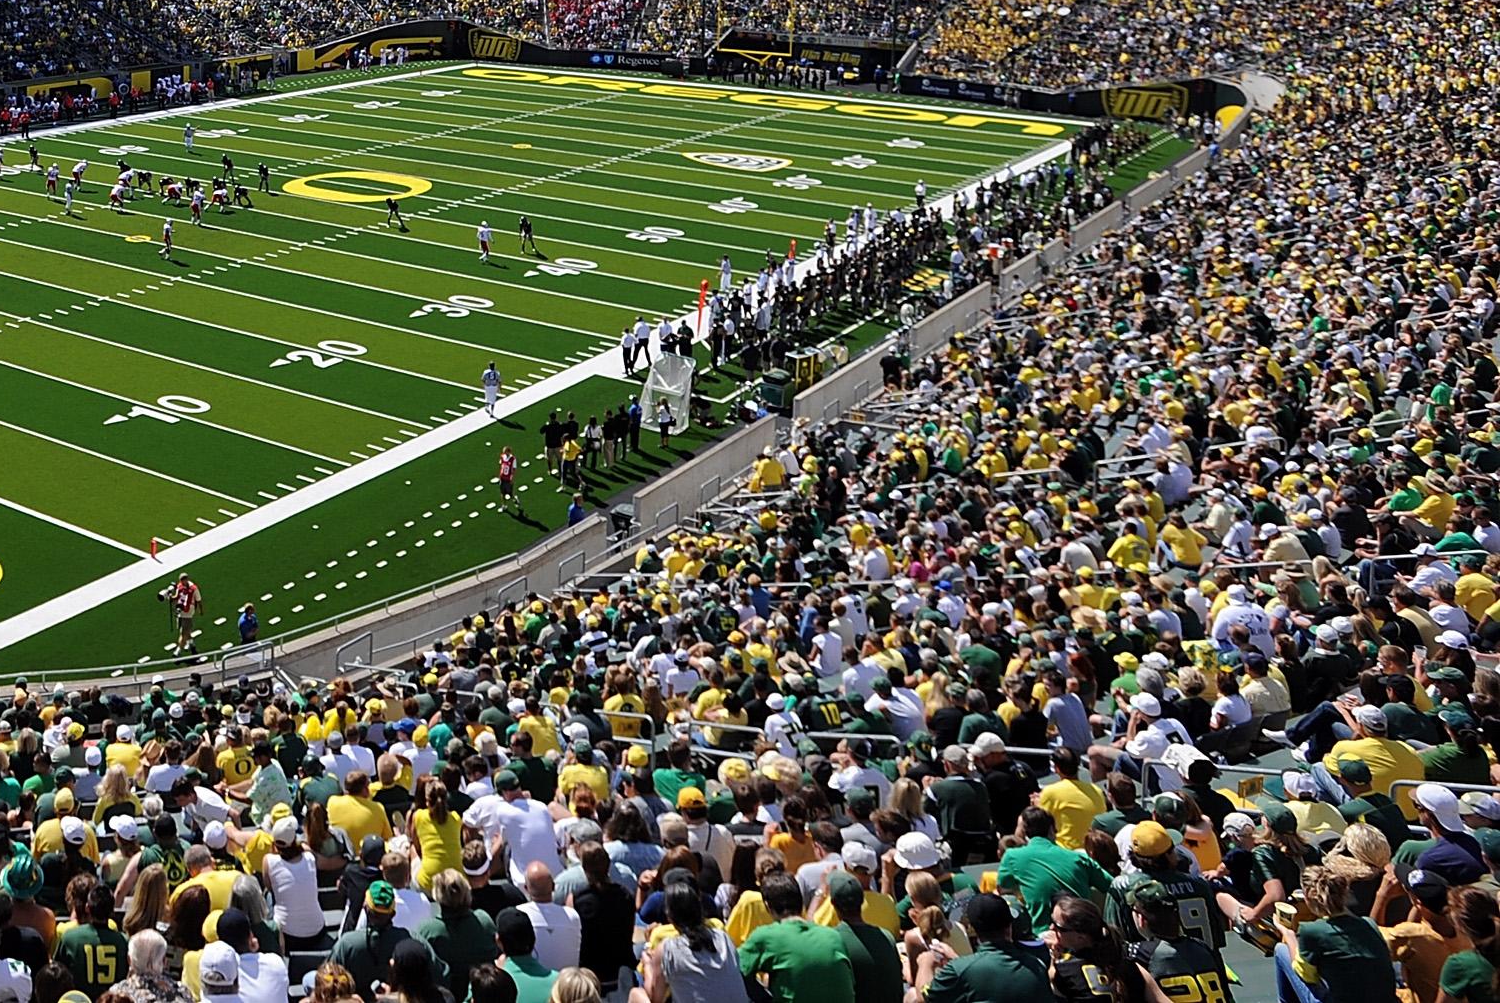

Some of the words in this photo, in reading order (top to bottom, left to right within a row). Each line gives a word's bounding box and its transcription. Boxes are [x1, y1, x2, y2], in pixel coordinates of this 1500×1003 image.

[617, 55, 660, 66] Regence
[463, 70, 1064, 135] OREGON
[283, 169, 432, 203] O
[626, 225, 685, 245] 50
[536, 257, 599, 277] 40
[422, 294, 495, 318] 30
[285, 339, 369, 369] 20
[127, 395, 212, 424] 10
[819, 703, 842, 725] 10
[235, 759, 251, 775] O
[83, 943, 116, 985] 15
